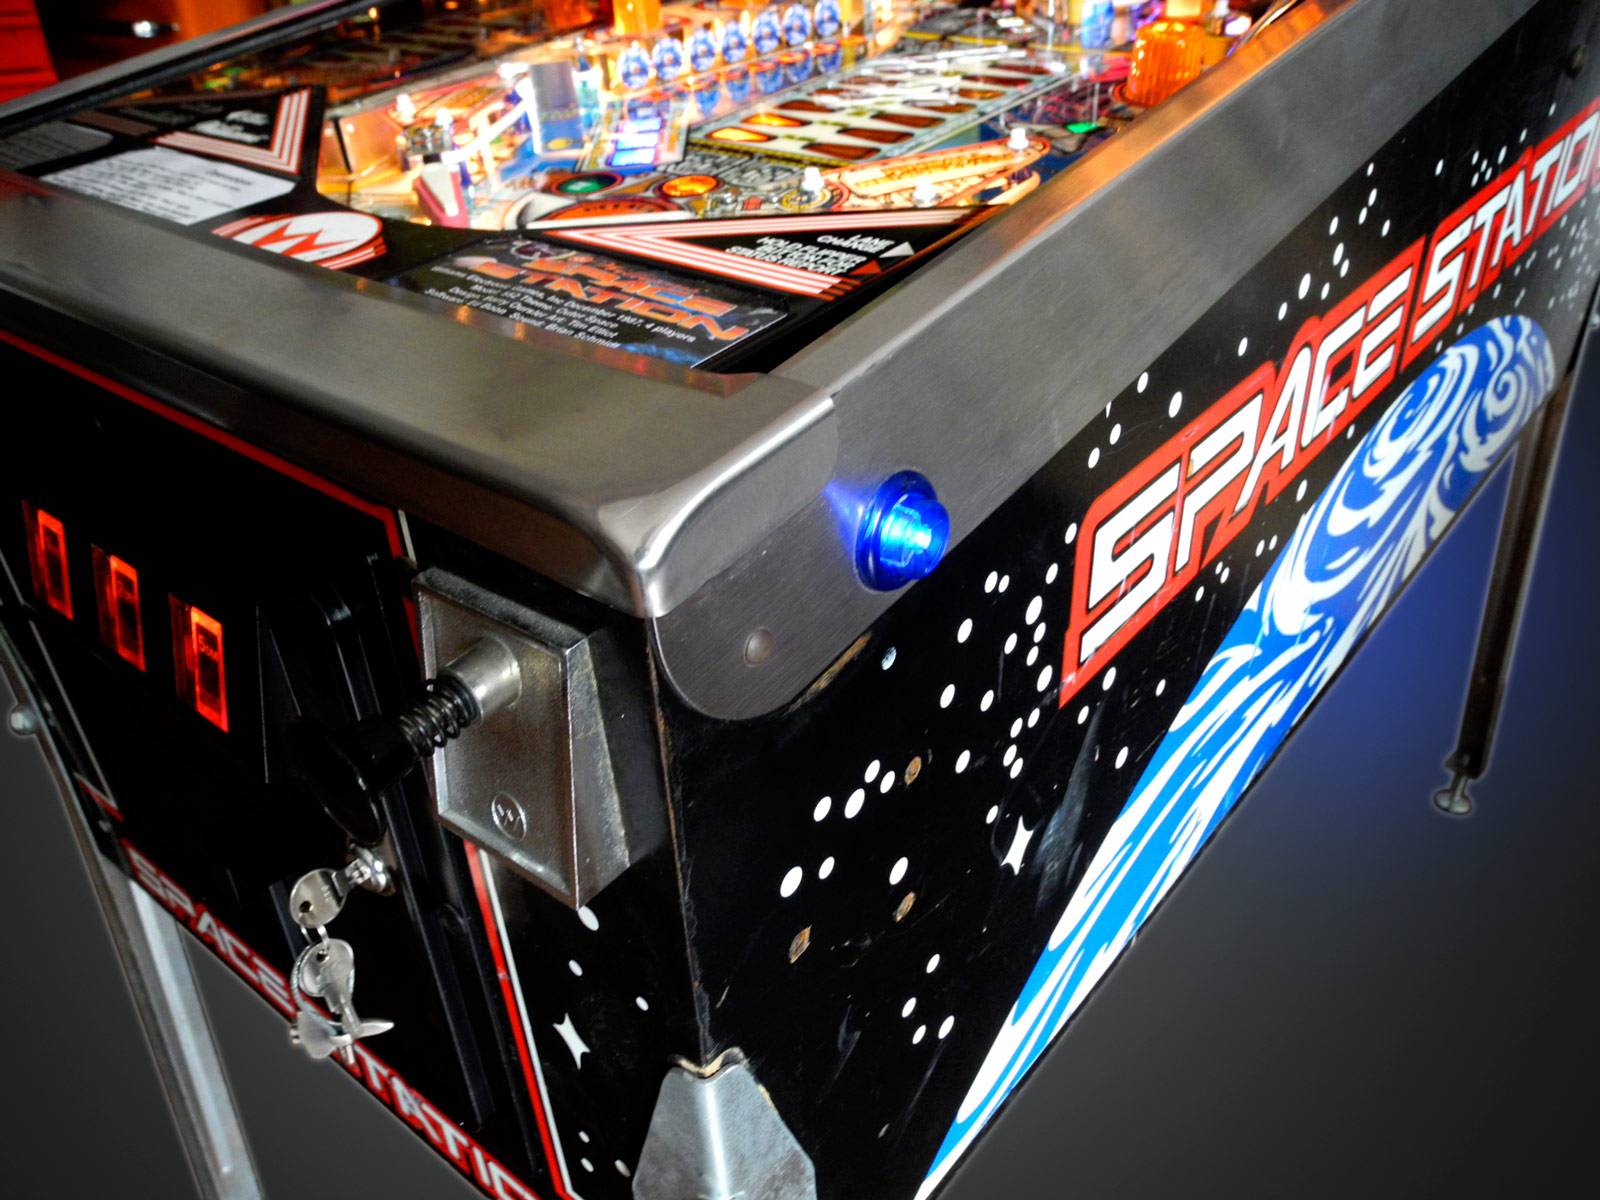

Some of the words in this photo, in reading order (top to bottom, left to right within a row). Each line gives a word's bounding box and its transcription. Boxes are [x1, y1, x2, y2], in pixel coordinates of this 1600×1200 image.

[471, 262, 749, 341] STATION
[1080, 268, 1412, 662] SPACE
[126, 847, 297, 1014] SPACE
